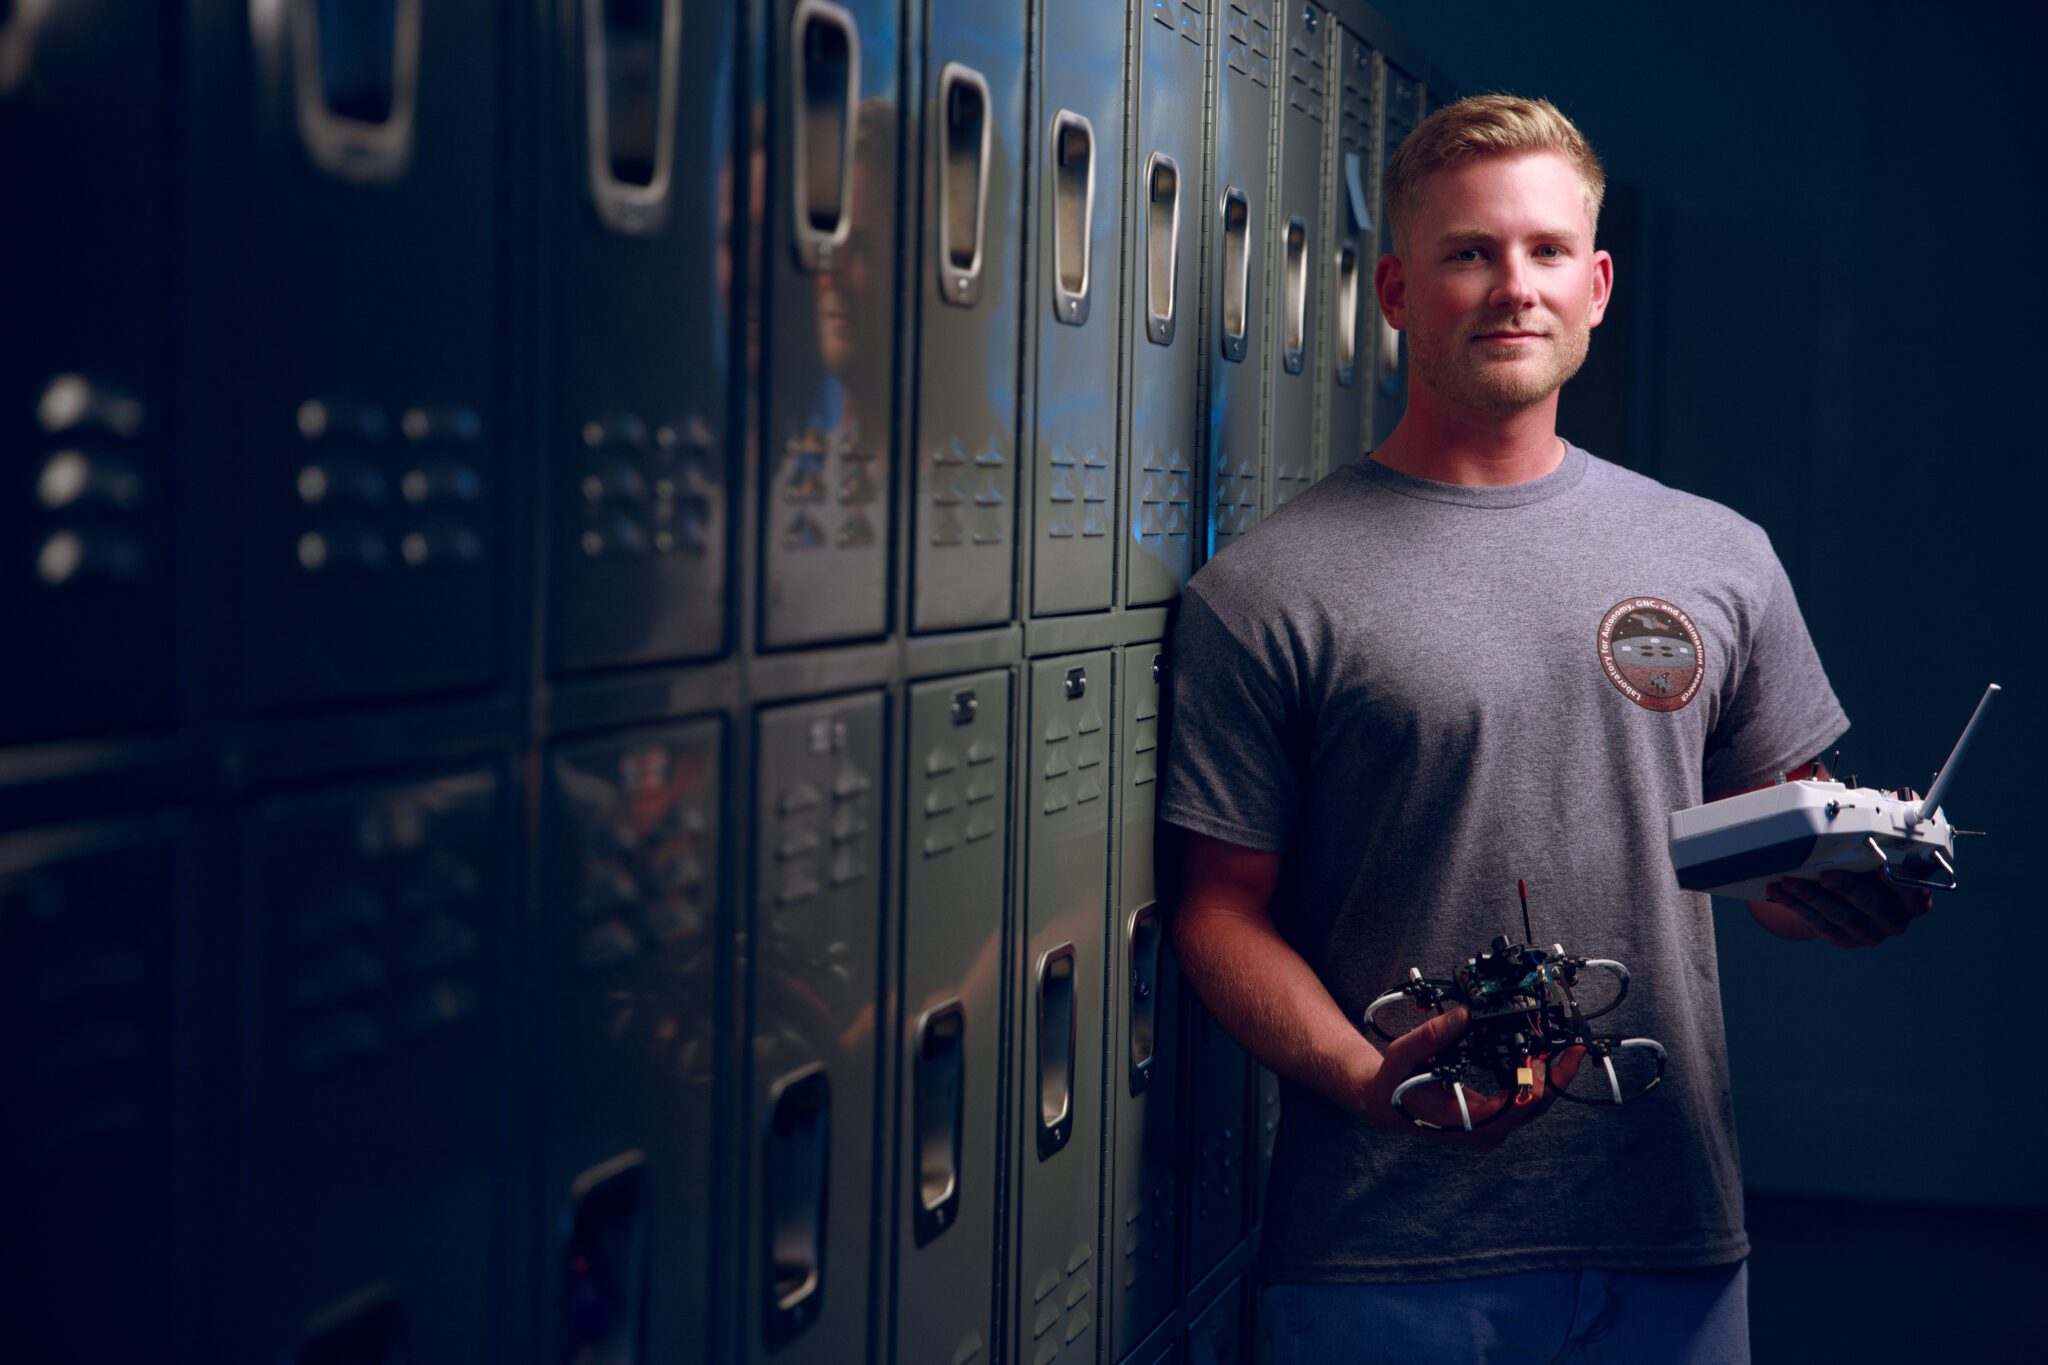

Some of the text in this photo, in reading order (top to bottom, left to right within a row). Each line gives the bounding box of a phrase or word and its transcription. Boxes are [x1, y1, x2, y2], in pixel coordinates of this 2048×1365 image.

[1603, 604, 1635, 638] Autonomy,
[1662, 605, 1679, 615] and
[1680, 615, 1703, 664] Estimation
[1604, 656, 1642, 700] Laboratory
[1681, 668, 1703, 701] Research
